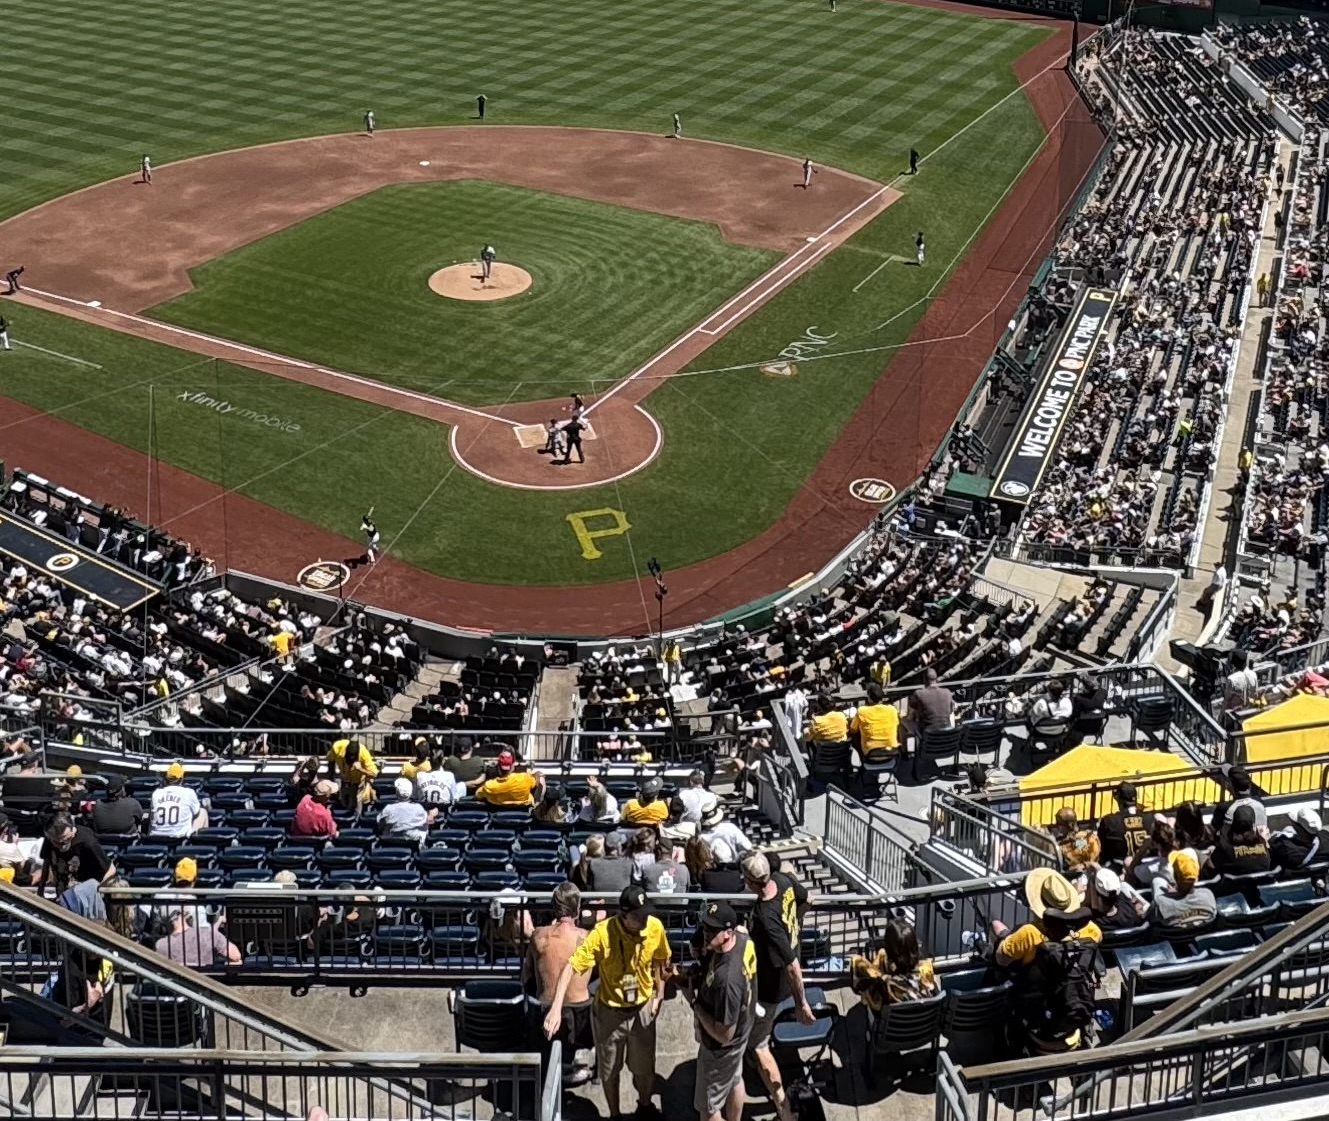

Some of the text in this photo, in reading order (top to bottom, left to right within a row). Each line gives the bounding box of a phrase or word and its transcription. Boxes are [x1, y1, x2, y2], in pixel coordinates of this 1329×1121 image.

[1089, 292, 1112, 302] P
[777, 325, 838, 360] PNC
[1018, 314, 1101, 458] WELCOME TO PNC PARK
[175, 389, 302, 433] xfinity mobile
[566, 506, 632, 559] P
[424, 789, 440, 802] 10
[155, 806, 179, 826] 30
